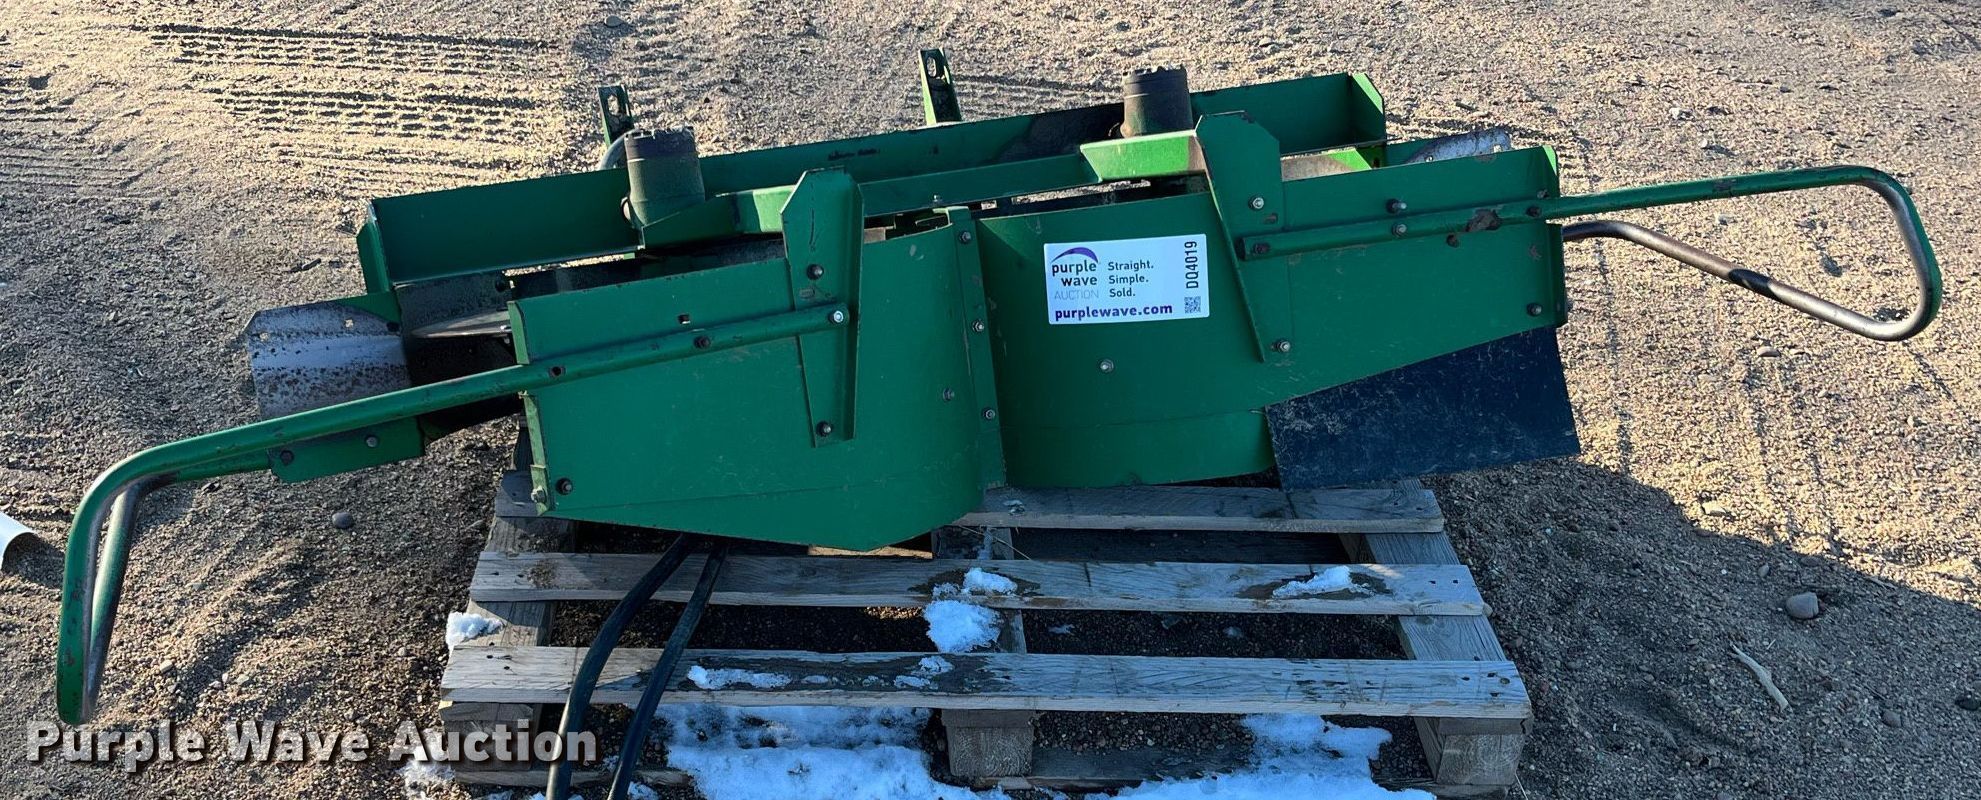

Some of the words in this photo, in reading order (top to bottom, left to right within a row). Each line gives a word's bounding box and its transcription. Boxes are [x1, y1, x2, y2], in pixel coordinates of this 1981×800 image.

[1051, 260, 1097, 276] purple
[1107, 260, 1154, 272] Straight.
[1184, 241, 1199, 289] DQ4019
[1061, 275, 1098, 287] wave
[1108, 273, 1149, 285] Simple.
[1054, 289, 1099, 300] AUCTION
[1109, 288, 1136, 298] Sold.
[1055, 304, 1173, 322] purplewave.com
